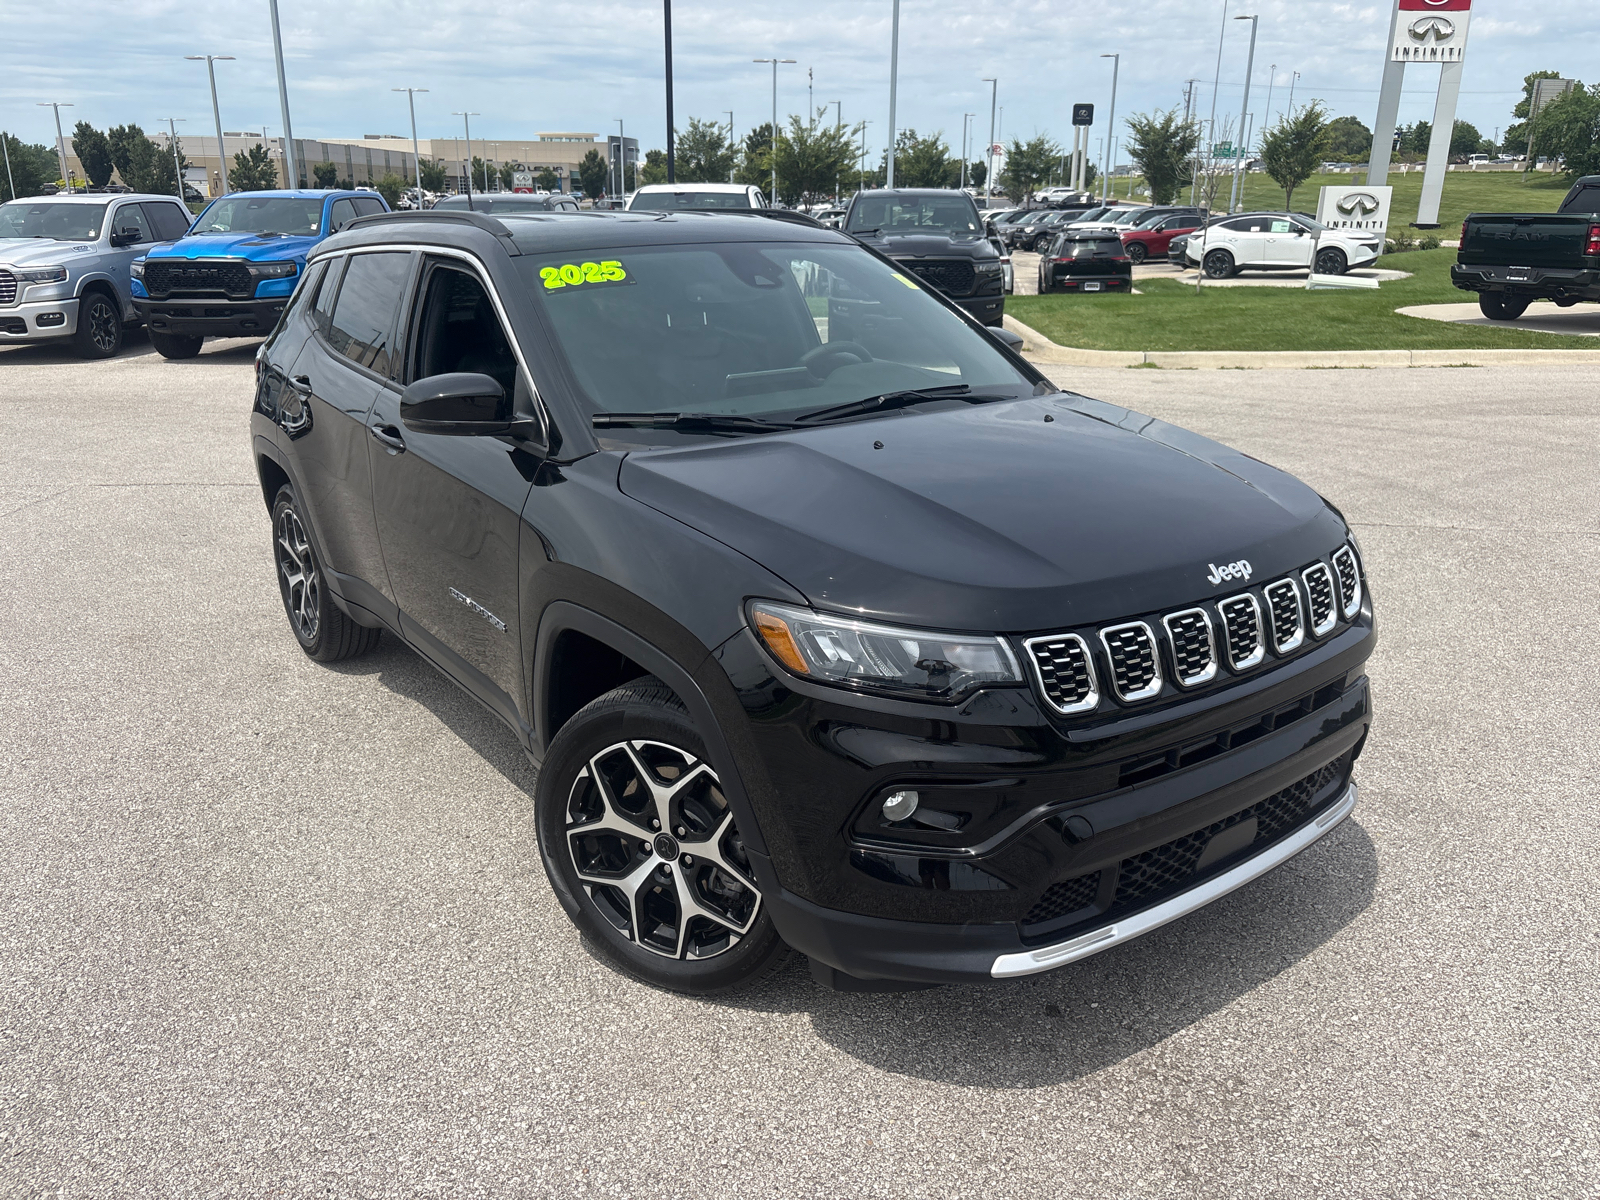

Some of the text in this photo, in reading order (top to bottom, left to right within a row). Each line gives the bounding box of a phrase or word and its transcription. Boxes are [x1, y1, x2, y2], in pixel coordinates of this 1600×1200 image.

[1394, 46, 1463, 57] INFINITI
[1326, 220, 1384, 229] INFINITI
[1494, 232, 1551, 241] RAM
[168, 269, 219, 277] RAM
[540, 260, 627, 290] 2025
[1206, 559, 1253, 585] Jeep
